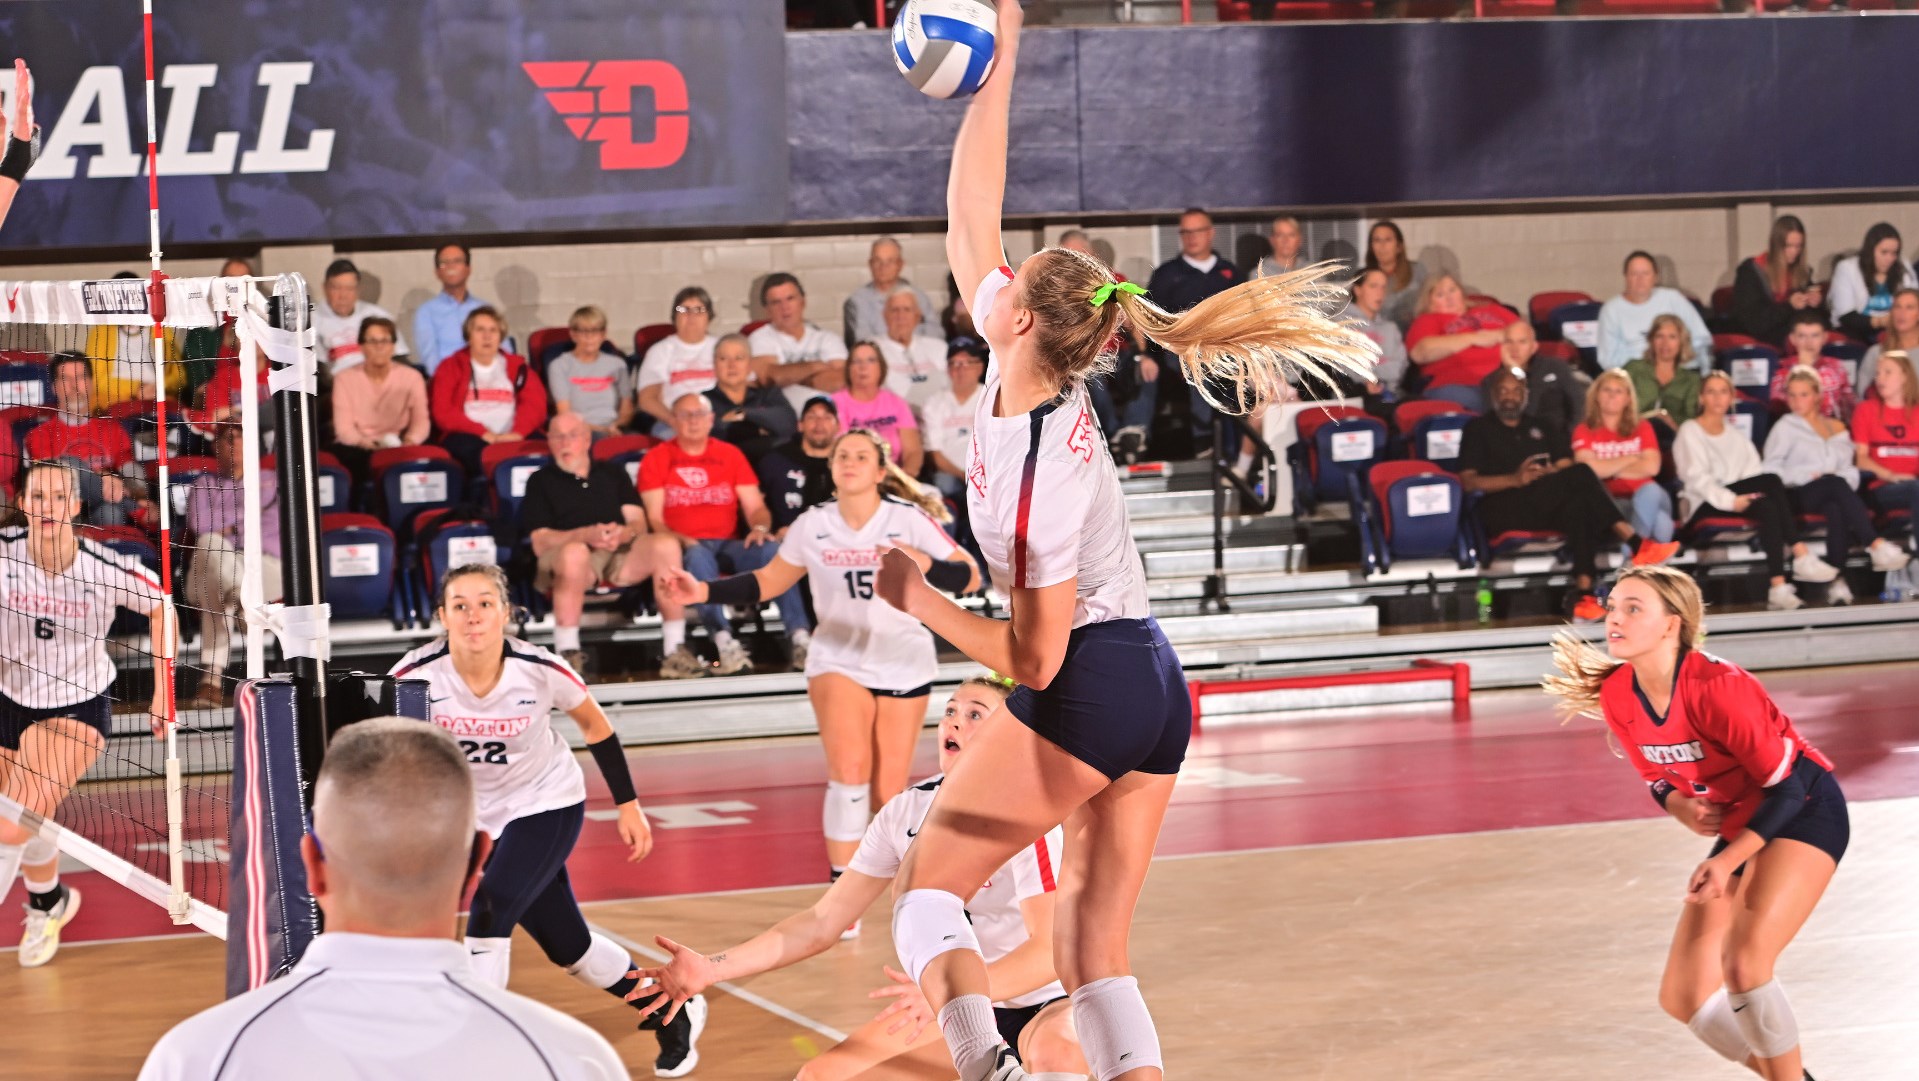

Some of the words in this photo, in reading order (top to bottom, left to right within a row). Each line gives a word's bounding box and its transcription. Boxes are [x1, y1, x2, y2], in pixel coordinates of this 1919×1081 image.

[0, 62, 336, 180] ALL
[822, 549, 880, 566] DAYTO
[844, 570, 874, 600] 15
[35, 618, 54, 639] 6
[435, 715, 531, 738] DAYTON
[458, 740, 508, 765] 22
[1637, 740, 1705, 765] AYTON
